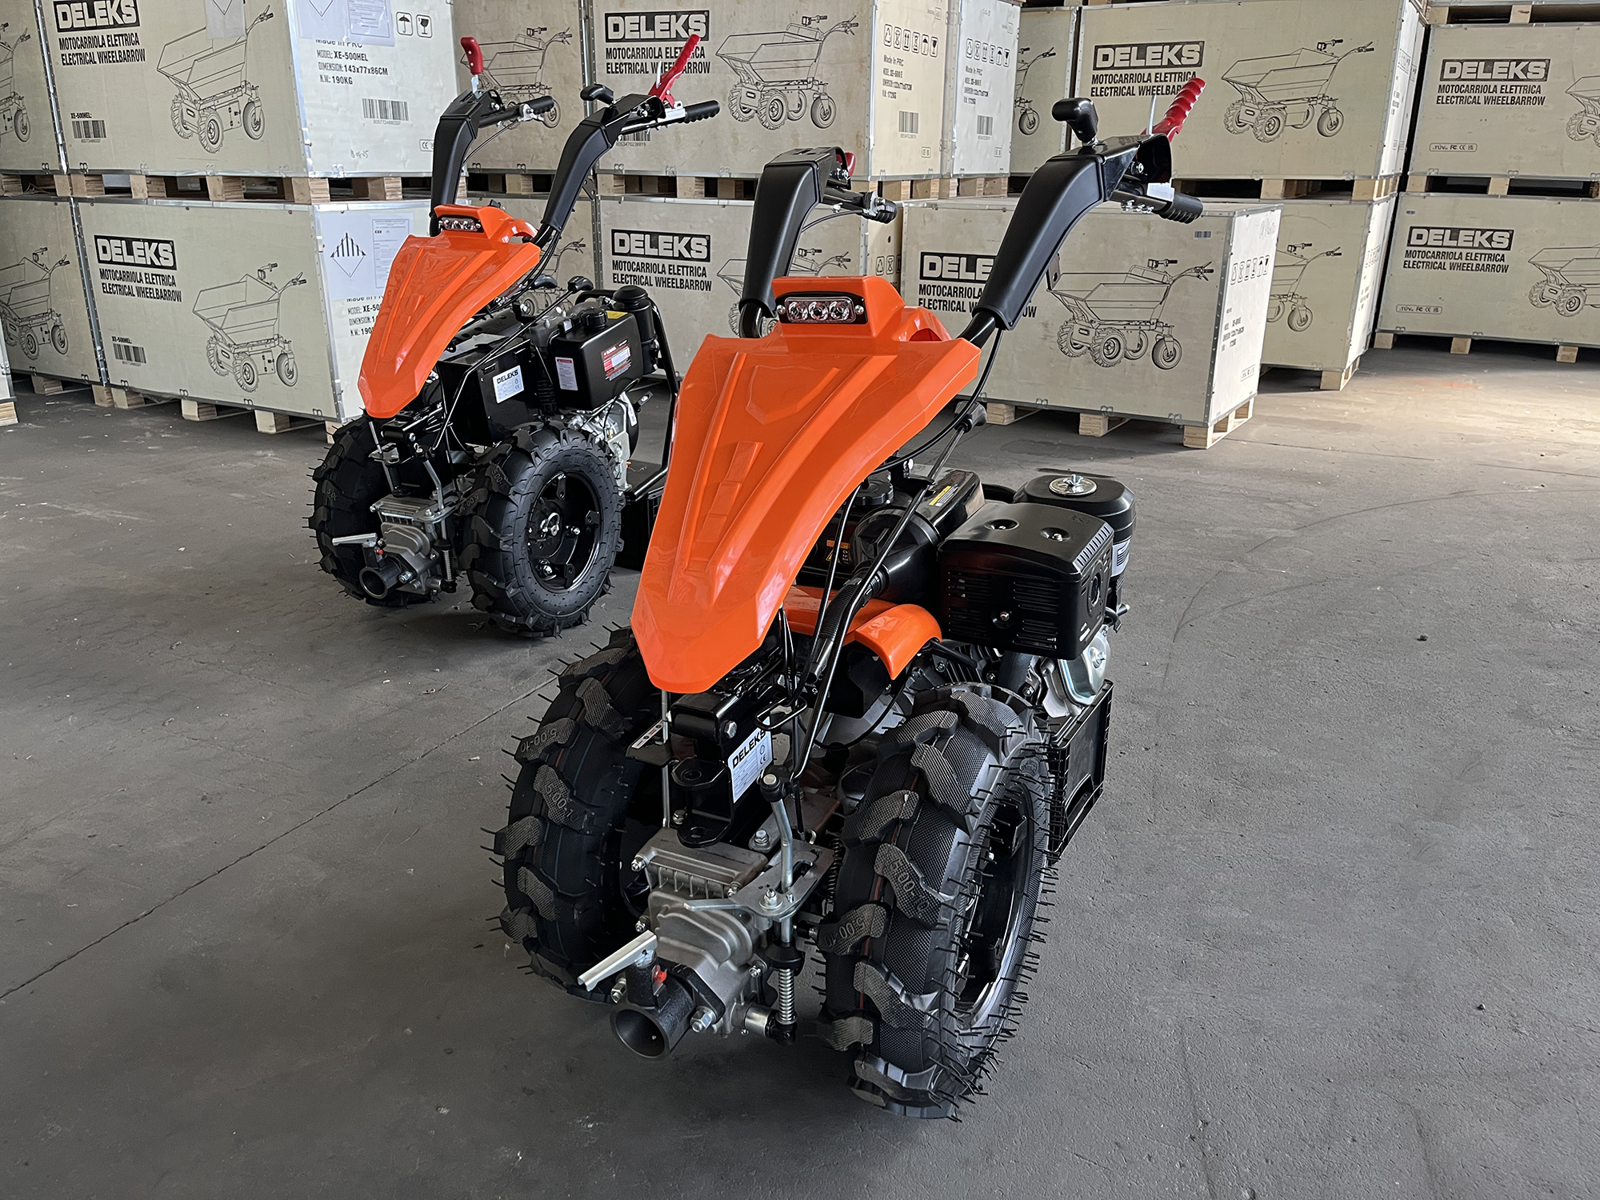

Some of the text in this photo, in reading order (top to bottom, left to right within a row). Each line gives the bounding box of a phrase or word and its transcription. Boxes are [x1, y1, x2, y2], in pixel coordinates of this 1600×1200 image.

[56, 0, 137, 29] DELEKS
[607, 14, 707, 40] DELEKS
[59, 32, 140, 50] MOTOCARRIOLA ELETTRICA
[61, 48, 146, 66] ELECTRICAL WHEELBARROW
[333, 50, 368, 62] XE-500HEL
[605, 46, 705, 60] MOTOCARRIOLA ELEICA
[1096, 43, 1201, 68] DELEKS
[344, 64, 388, 76] 143x77x86CM
[606, 61, 711, 74] ELECTRICAL WEEARROW
[1443, 61, 1546, 79] DELEKS
[331, 75, 353, 85] 190KG
[1091, 71, 1197, 85] MOTOCARRIOLA ELETTRICA
[1090, 85, 1183, 97] ELECTRICAL WHEELBAR
[1437, 84, 1541, 94] MOTOCARRIOLA ELETTRICA
[1436, 95, 1546, 106] ELECTRICAL WHEELBARROW
[614, 232, 708, 259] DELEKS
[1410, 228, 1510, 249] DELEKS
[97, 238, 174, 267] DELEKS
[1404, 249, 1505, 263] MOTOCARRIOLA ELETTRICA
[612, 259, 707, 278] MOTOCARRIOLA ELETTRICA
[922, 255, 994, 281] DELE
[1402, 260, 1509, 274] ELECTRICAL WHEELBARROW
[99, 267, 177, 287] MOTOCARRIOLA ELETTRICA
[612, 272, 712, 292] ELECTRICAL WHEELBARROW
[101, 282, 182, 302] ELECTRICAL WHEELBARROW
[919, 284, 983, 300] MOTOCARRIOLA
[362, 303, 381, 313] XE-50
[918, 298, 967, 313] ELECTRICAL
[360, 326, 374, 335] 190
[496, 369, 519, 384] DELEKS
[732, 729, 766, 769] DELEKS
